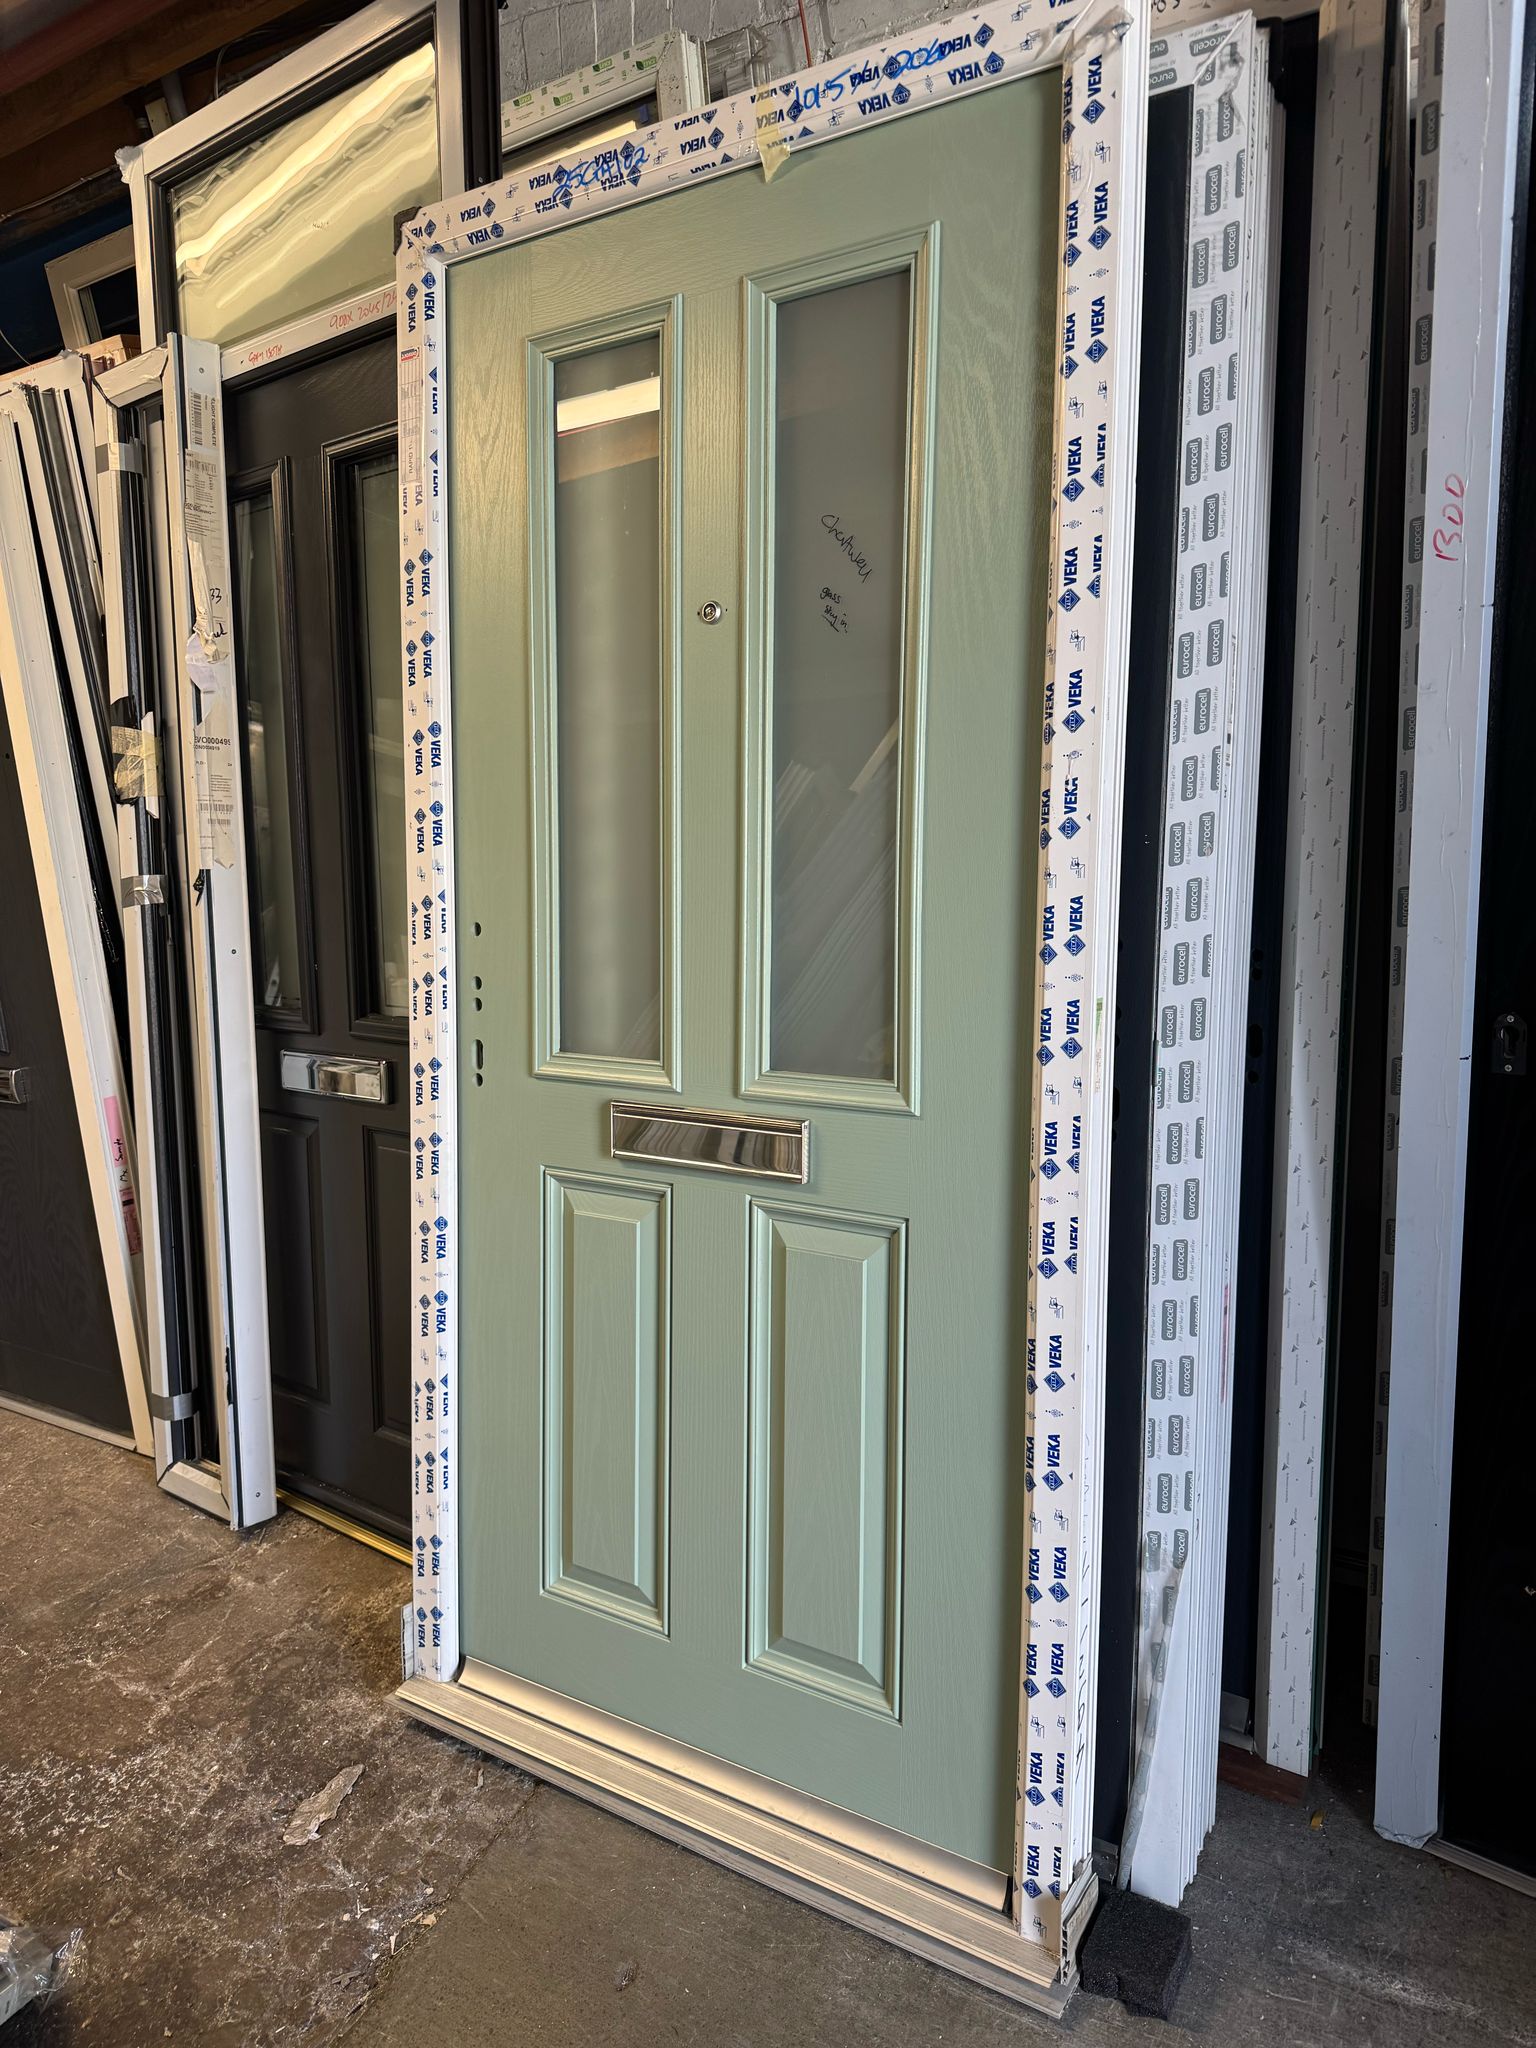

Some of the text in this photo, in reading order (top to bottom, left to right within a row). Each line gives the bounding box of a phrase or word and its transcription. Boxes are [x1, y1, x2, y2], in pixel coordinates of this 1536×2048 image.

[947, 62, 983, 85] VEKA
[1088, 54, 1102, 98] VEKA
[756, 109, 784, 129] VEKA
[858, 93, 891, 115] VEKA
[680, 136, 706, 155] VEKA
[529, 175, 551, 190] VEKA
[1210, 170, 1218, 210] eurocell
[461, 207, 480, 221] VEKA
[1066, 200, 1078, 240] VEKA
[1094, 181, 1108, 224] VEKA
[467, 229, 491, 245] VEKA
[1227, 226, 1235, 266] eurocell
[1197, 244, 1205, 283] eurocell
[407, 302, 416, 332] VEKA
[425, 292, 434, 320] VEKA
[1091, 296, 1105, 337] VEKA
[1215, 300, 1223, 339] eurocell
[1065, 313, 1075, 352] VEKA
[1420, 321, 1430, 361] eurocell
[1202, 372, 1210, 411] eurocell
[1068, 436, 1081, 476] VEKA
[1097, 423, 1106, 461] VEKA
[1219, 428, 1228, 467] eurocell
[1190, 445, 1198, 481] eurocell
[414, 484, 422, 506] EKA
[1207, 498, 1215, 537] eurocell
[1433, 474, 1464, 561] 1300
[1093, 535, 1102, 573] VEKA
[1413, 520, 1422, 560] eurocell
[422, 568, 430, 596] VEKA
[1064, 547, 1078, 586] VEKA
[1195, 568, 1203, 606] eurocell
[1182, 637, 1190, 674] eurocell
[1212, 624, 1220, 662] eurocell
[424, 650, 432, 677] VEKA
[1068, 669, 1082, 708] VEKA
[1199, 693, 1207, 730] eurocell
[1408, 710, 1416, 748] eurocell
[431, 740, 441, 767] VEKA
[1064, 777, 1078, 814] VEKA
[1186, 760, 1194, 797] eurocell
[1041, 791, 1050, 824] VEKA
[433, 819, 442, 846] VEKA
[1173, 827, 1181, 863] eurocell
[1069, 896, 1083, 932] VEKA
[1190, 881, 1198, 918] eurocell
[1043, 905, 1054, 941] VEKA
[1177, 946, 1186, 982] eurocell
[1040, 1008, 1051, 1042] VEKA
[1066, 1000, 1079, 1034] VEKA
[1165, 1009, 1173, 1045] eurocell
[1194, 1000, 1202, 1037] eurocell
[431, 1075, 439, 1100] VEKA
[1182, 1063, 1190, 1100] eurocell
[1045, 1122, 1057, 1155] VEKA
[1072, 1116, 1081, 1149] VEKA
[1171, 1126, 1179, 1161] eurocell
[431, 1150, 439, 1175] VEKA
[1188, 1182, 1196, 1217] eurocell
[437, 1234, 446, 1259] VEKA
[1042, 1222, 1055, 1255] VEKA
[1070, 1217, 1078, 1250] VEKA
[1176, 1243, 1184, 1278] eurocell
[437, 1308, 446, 1333] VEKA
[1165, 1303, 1174, 1339] eurocell
[1049, 1335, 1062, 1368] VEKA
[1156, 1361, 1164, 1398] eurocell
[1026, 1437, 1034, 1469] VEKA
[1048, 1435, 1060, 1467] VEKA
[1172, 1417, 1180, 1454] eurocell
[1161, 1476, 1170, 1512] eurocell
[1029, 1548, 1039, 1580] VEKA
[1054, 1547, 1066, 1579] VEKA
[1026, 1643, 1037, 1675] VEKA
[1051, 1644, 1063, 1675] VEKA
[1030, 1753, 1042, 1784] VEKA
[1056, 1753, 1064, 1784] VEKA
[1027, 1845, 1039, 1876] VEKA
[1053, 1847, 1061, 1877] VEKA
